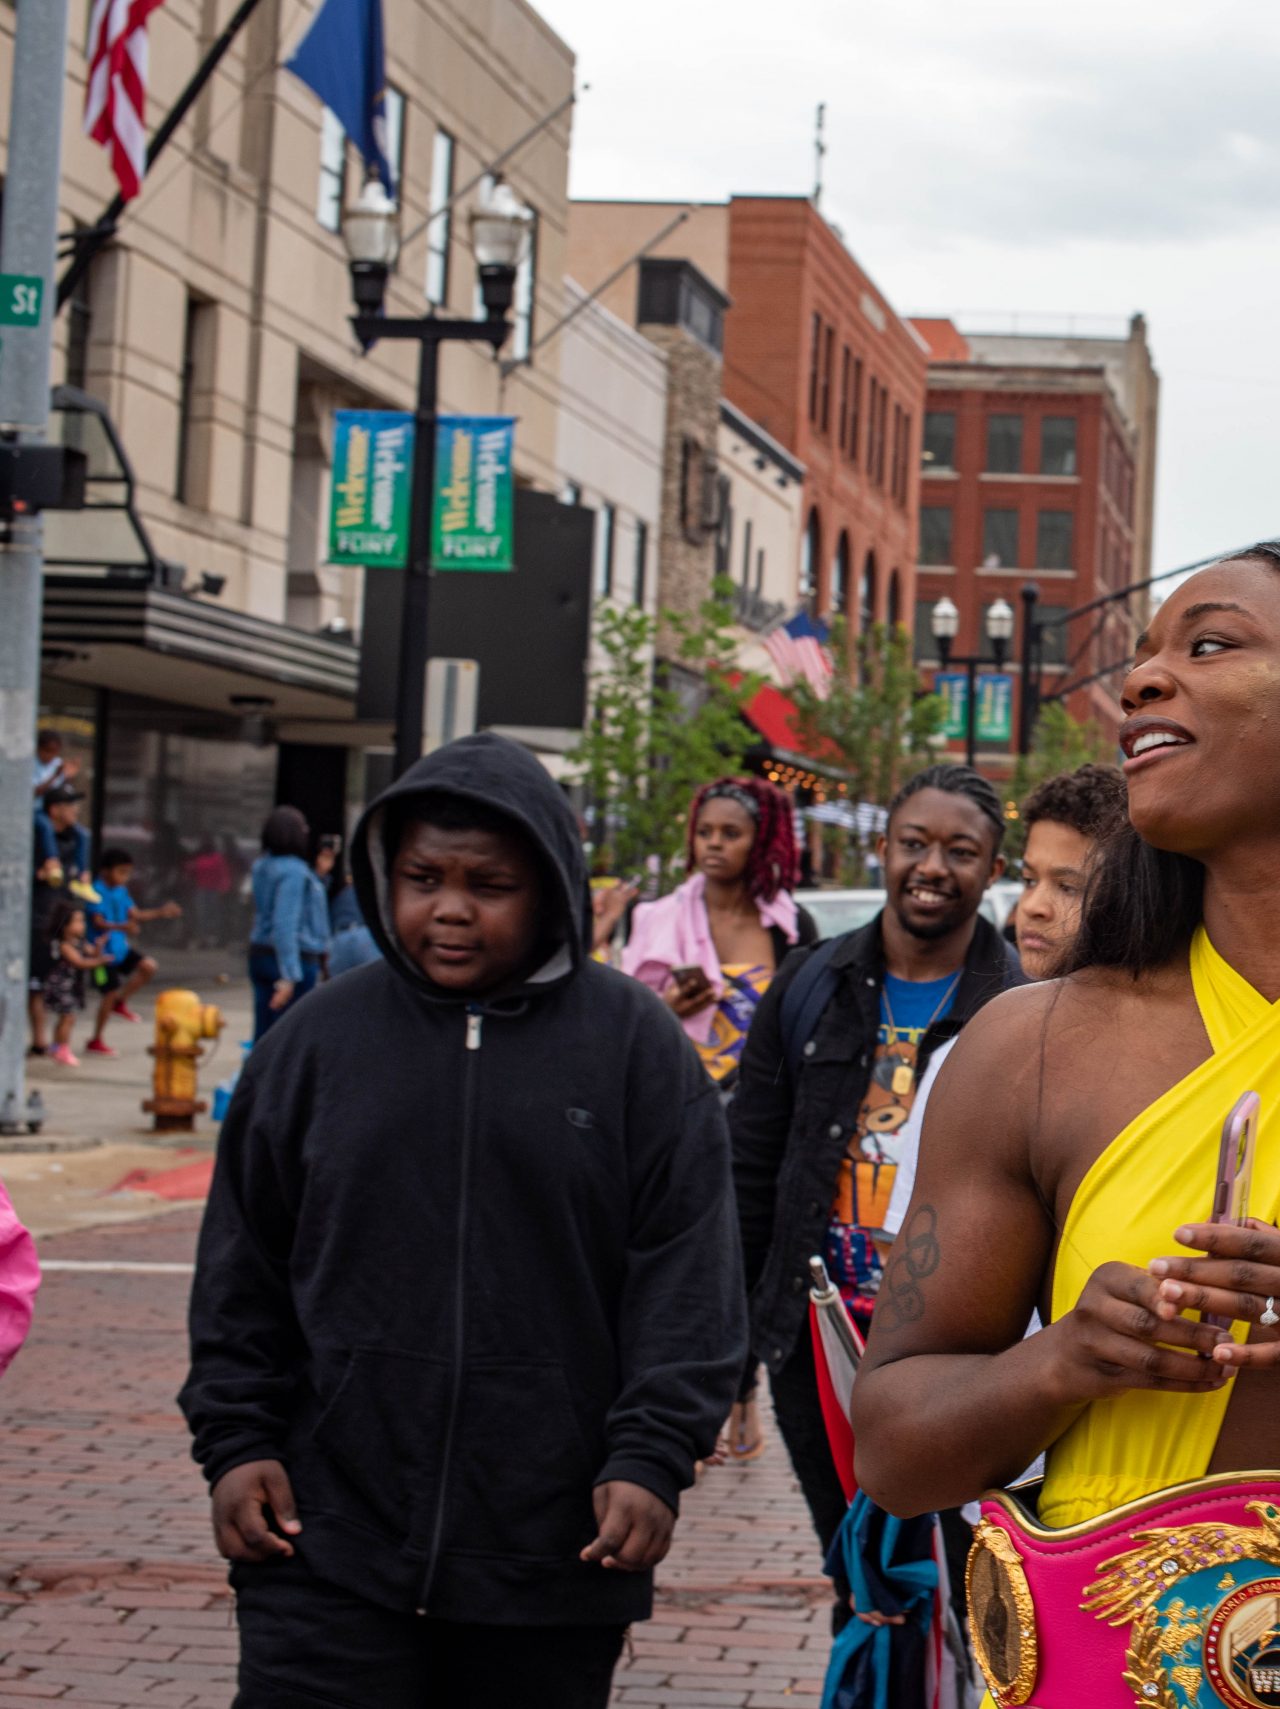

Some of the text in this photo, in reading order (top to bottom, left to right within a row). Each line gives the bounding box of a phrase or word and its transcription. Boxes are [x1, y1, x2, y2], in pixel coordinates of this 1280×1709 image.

[11, 284, 37, 314] St
[336, 424, 370, 528] Welcome
[371, 427, 405, 531] Welcome
[440, 428, 472, 532] Welcome
[474, 429, 507, 533] Welcome
[337, 533, 397, 555] FLINT
[442, 537, 502, 558] FLINT
[1214, 1592, 1247, 1623] WORLD
